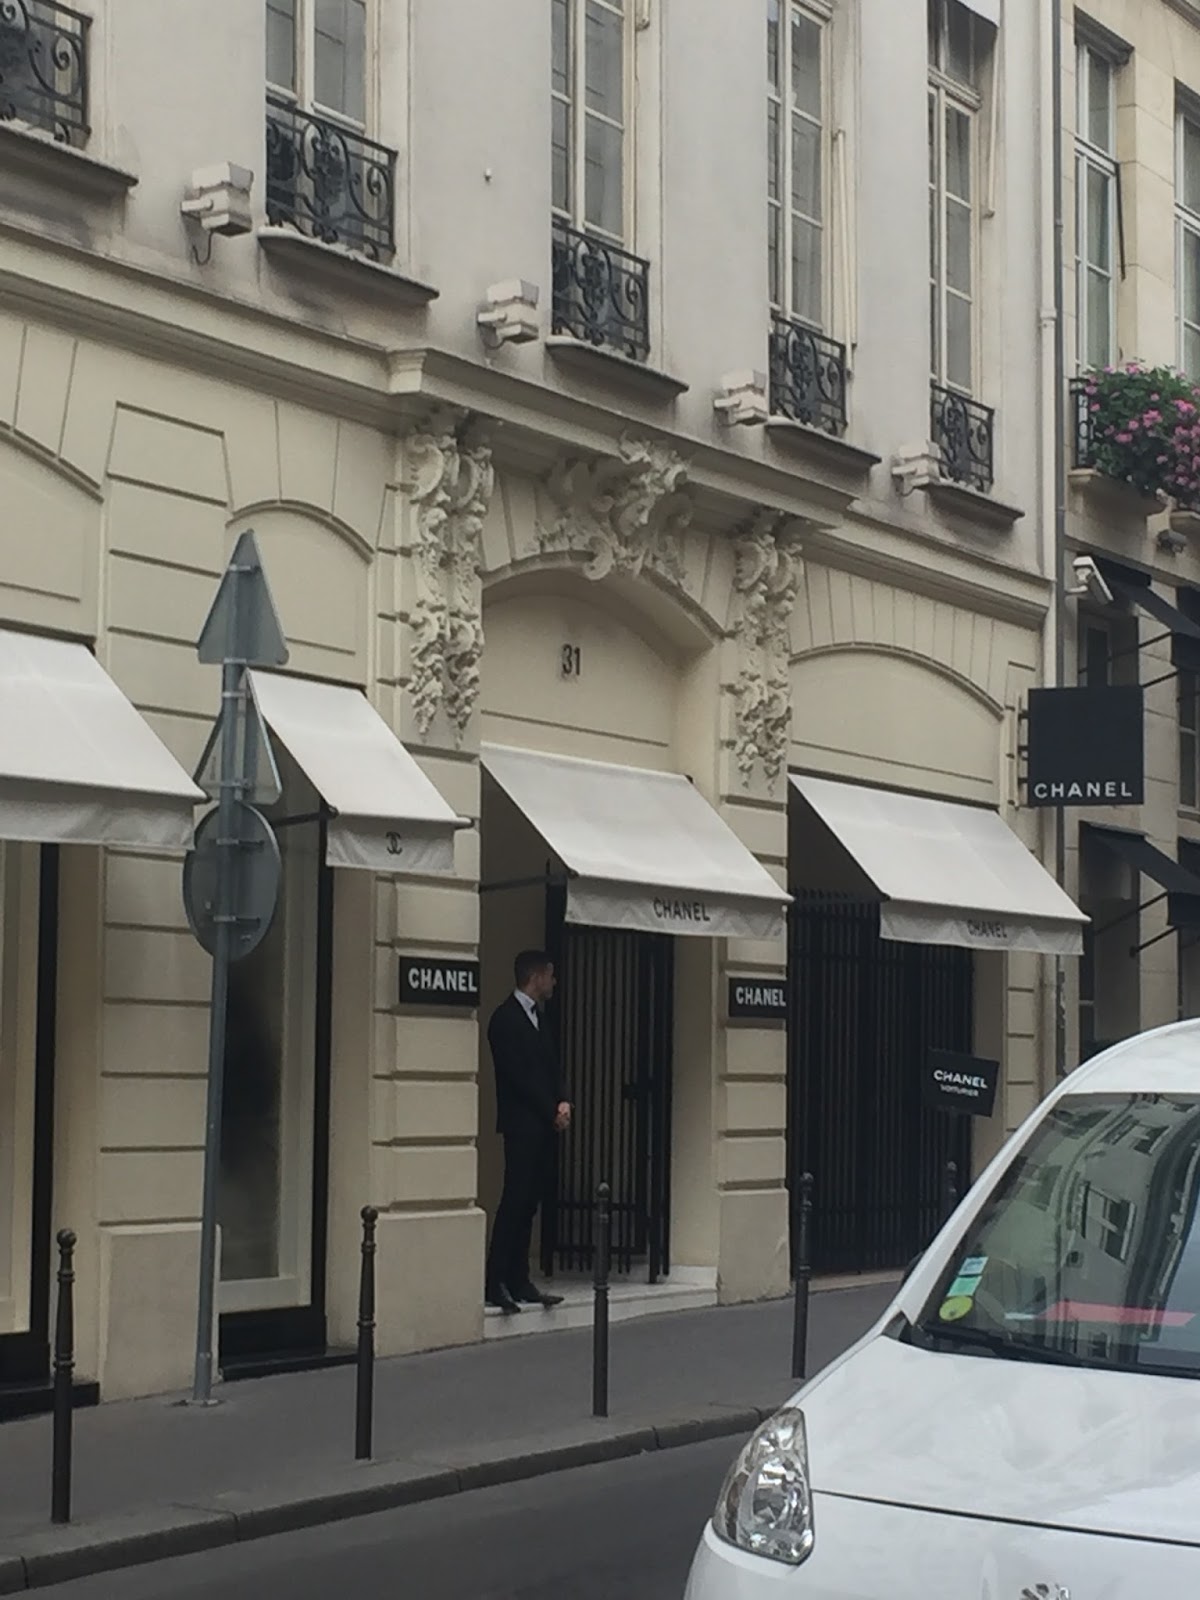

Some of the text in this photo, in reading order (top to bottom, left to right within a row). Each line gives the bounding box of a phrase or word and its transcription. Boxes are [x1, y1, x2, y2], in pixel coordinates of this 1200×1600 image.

[562, 643, 580, 676] 31
[1034, 781, 1133, 799] CHANEL
[653, 896, 711, 921] CHANEL
[408, 967, 478, 992] CHANEL
[735, 986, 787, 1007] CHANEL
[933, 1069, 989, 1089] CHANEL
